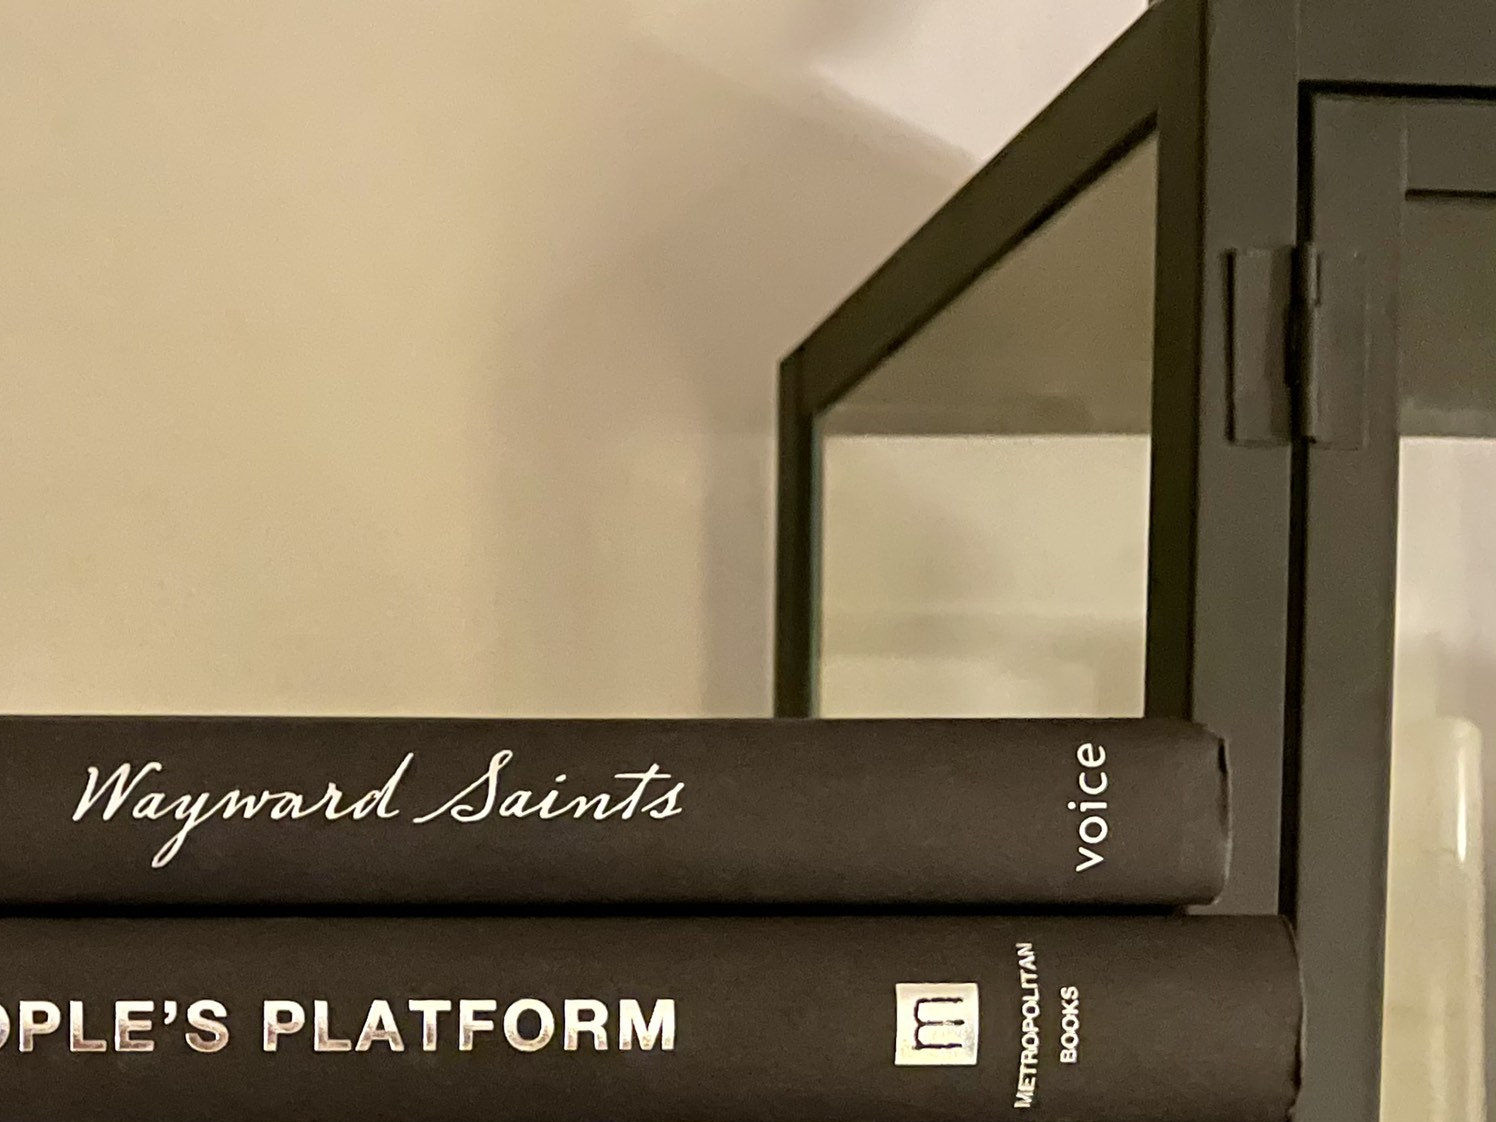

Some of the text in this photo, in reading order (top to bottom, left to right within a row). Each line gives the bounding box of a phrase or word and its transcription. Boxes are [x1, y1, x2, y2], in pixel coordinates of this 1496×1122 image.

[72, 750, 685, 868] Wayward Saints
[1068, 743, 1108, 871] voice
[264, 999, 675, 1052] PLATFORM
[1014, 943, 1038, 1109] METROPOLITAN
[1060, 986, 1079, 1063] BOOKS
